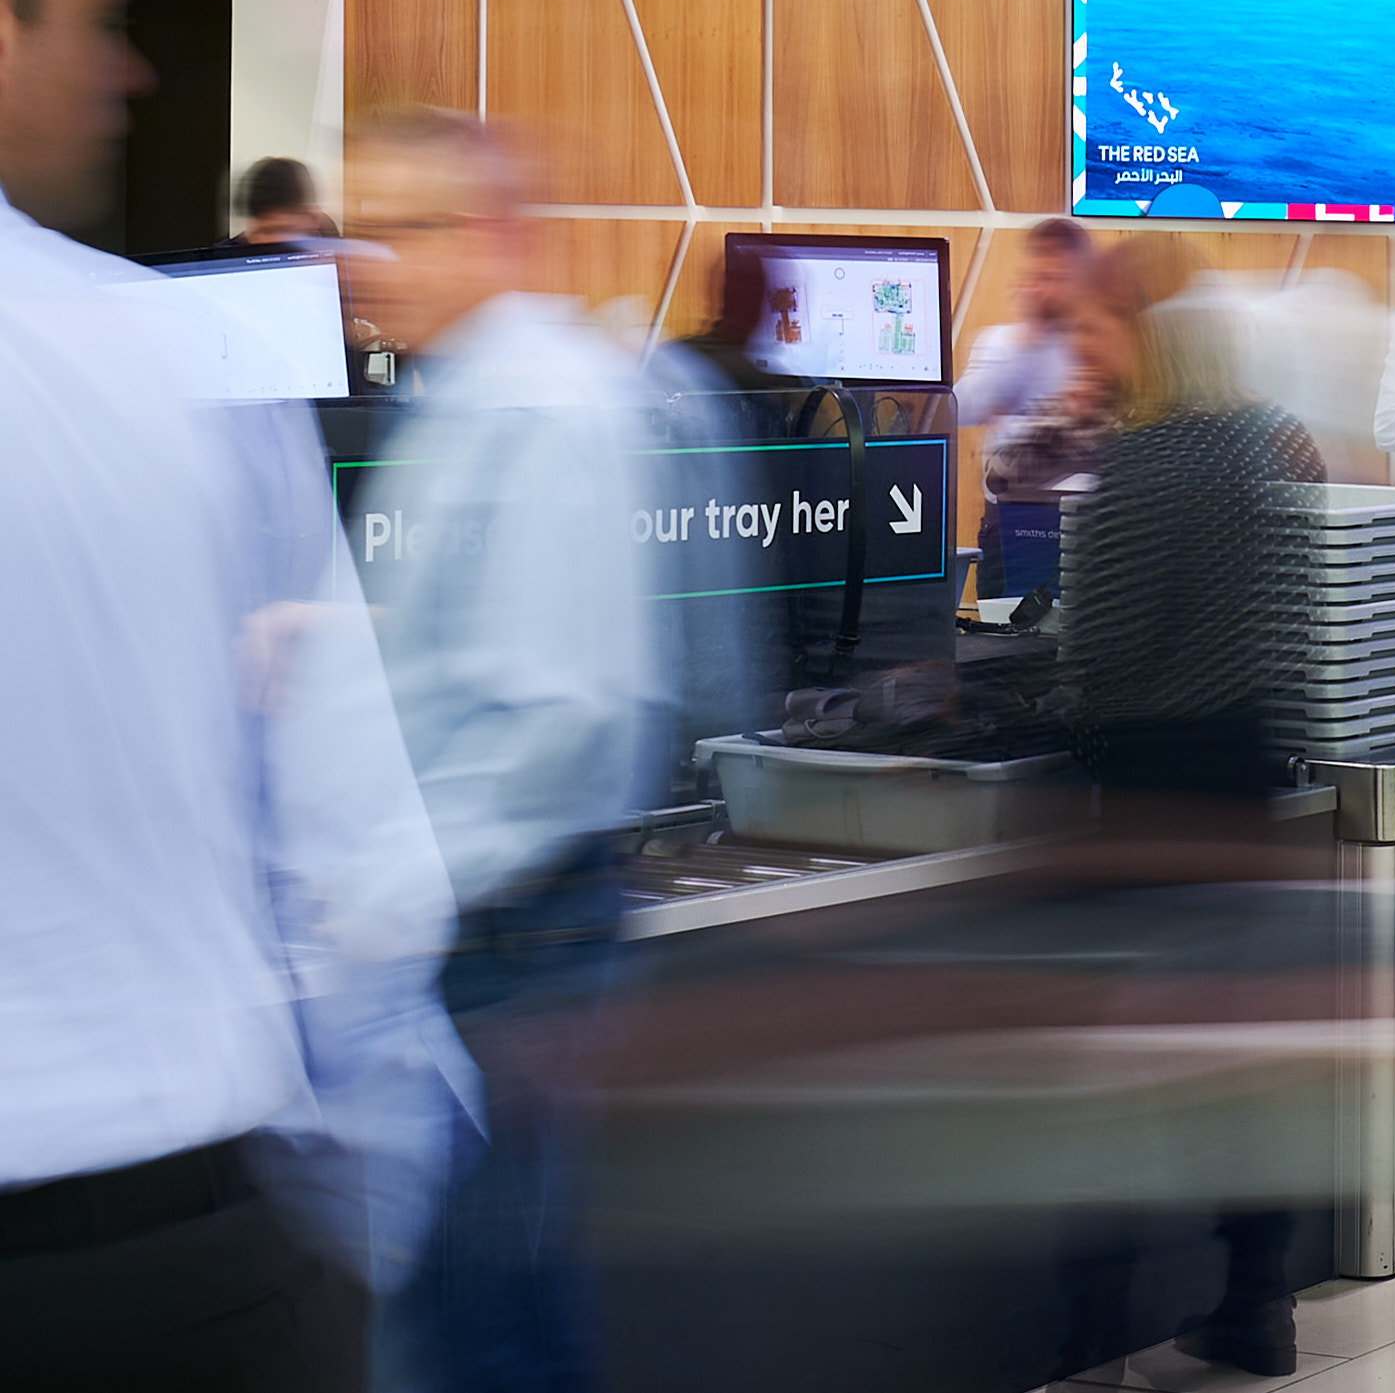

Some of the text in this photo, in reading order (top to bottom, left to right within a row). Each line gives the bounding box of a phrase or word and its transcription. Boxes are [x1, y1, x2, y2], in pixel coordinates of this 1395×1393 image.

[1098, 145, 1200, 163] THE RED SEA
[1114, 168, 1183, 185] البحر الأحمر
[630, 507, 695, 544] our
[705, 498, 781, 548] tray
[792, 490, 850, 534] her
